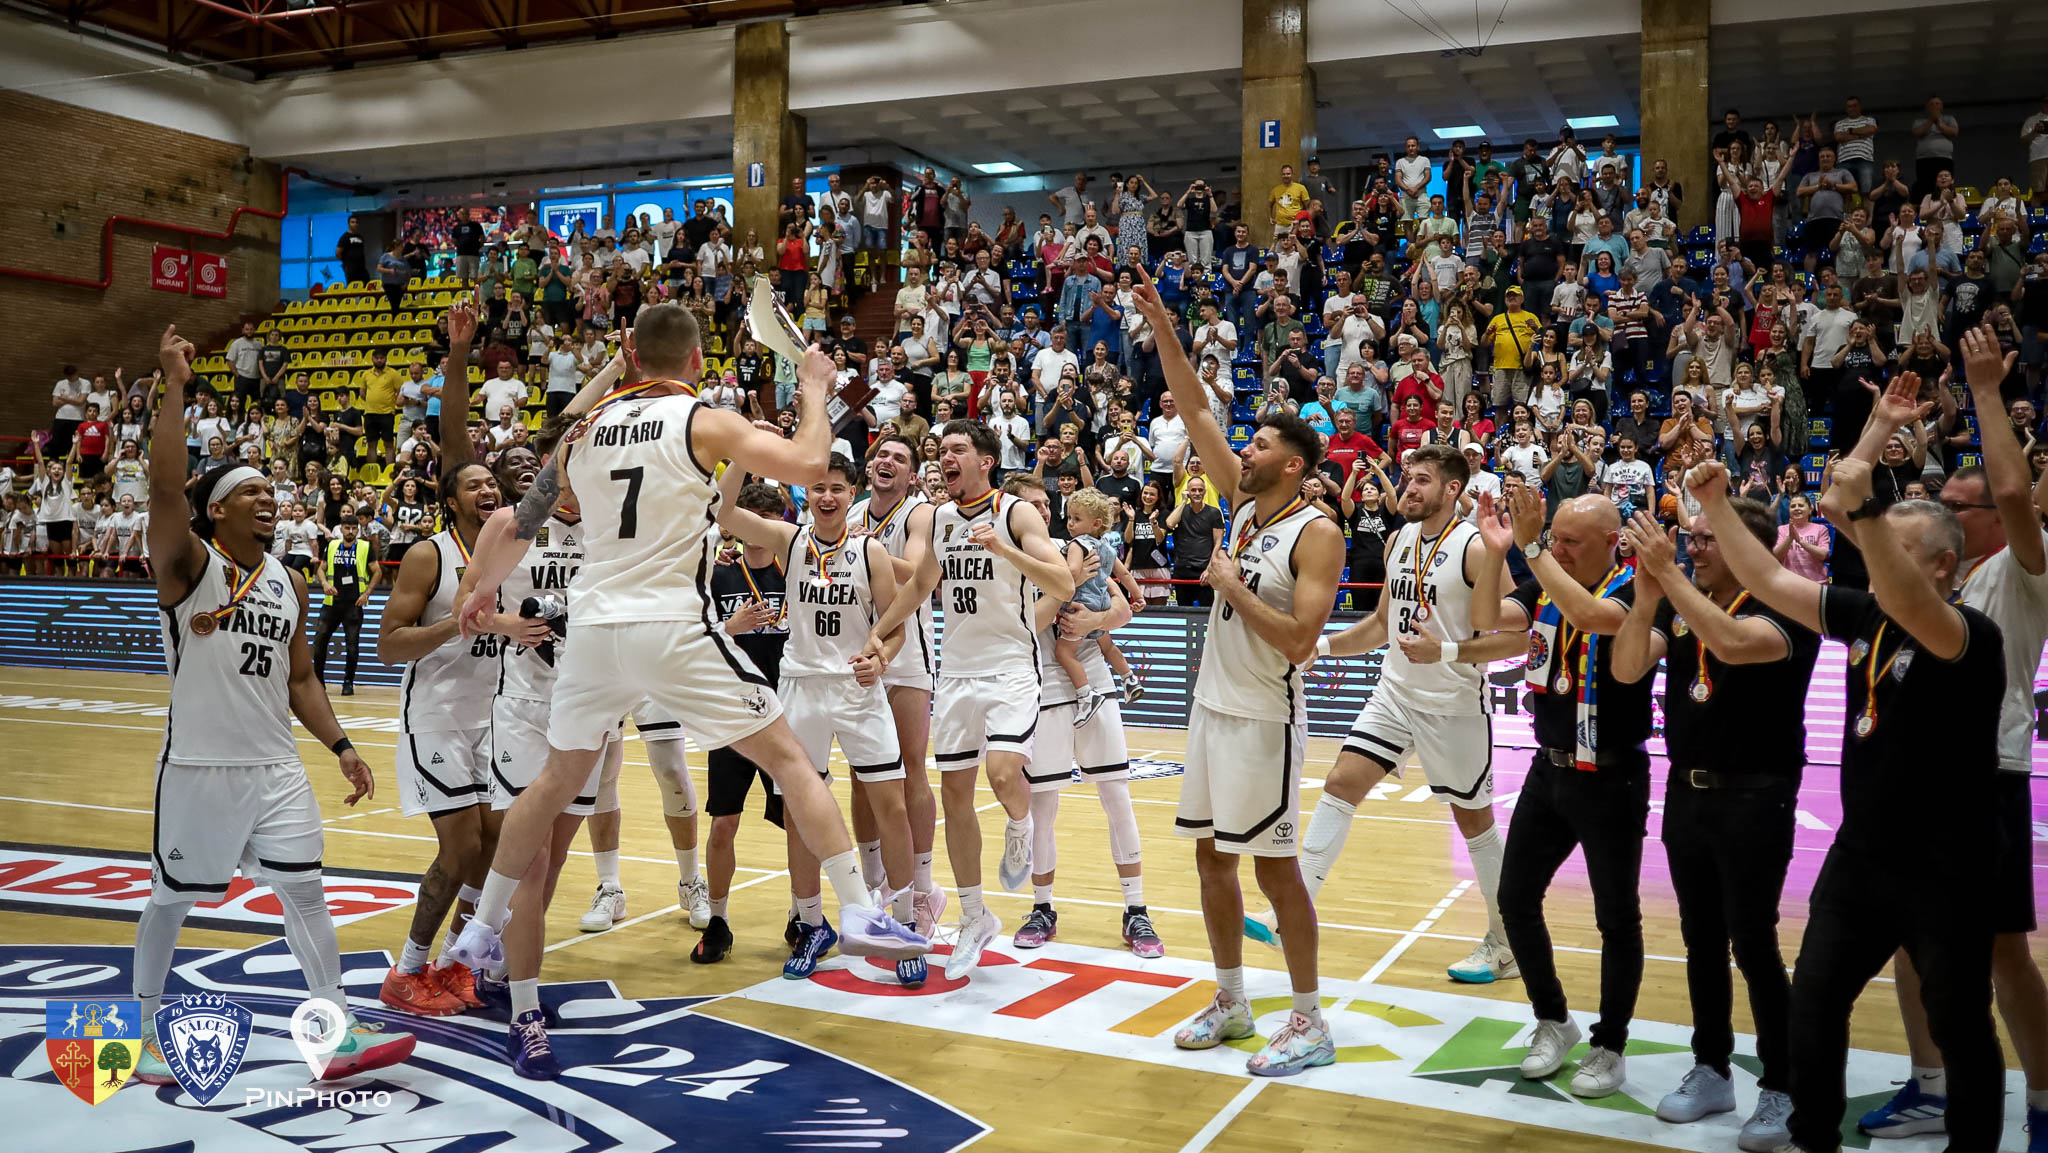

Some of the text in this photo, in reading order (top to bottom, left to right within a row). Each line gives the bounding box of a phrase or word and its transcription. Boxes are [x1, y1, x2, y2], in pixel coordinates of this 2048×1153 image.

[1265, 121, 1275, 146] E
[751, 163, 762, 187] D
[156, 277, 184, 289] HIDRANT
[196, 283, 222, 293] HIDRANT
[594, 420, 664, 447] ROTARU
[610, 466, 644, 539] 7
[397, 507, 423, 525] 92
[953, 586, 978, 614] 38
[815, 610, 841, 637] 66
[470, 633, 497, 658] 55
[239, 641, 274, 678] 25
[559, 1043, 790, 1101] 24
